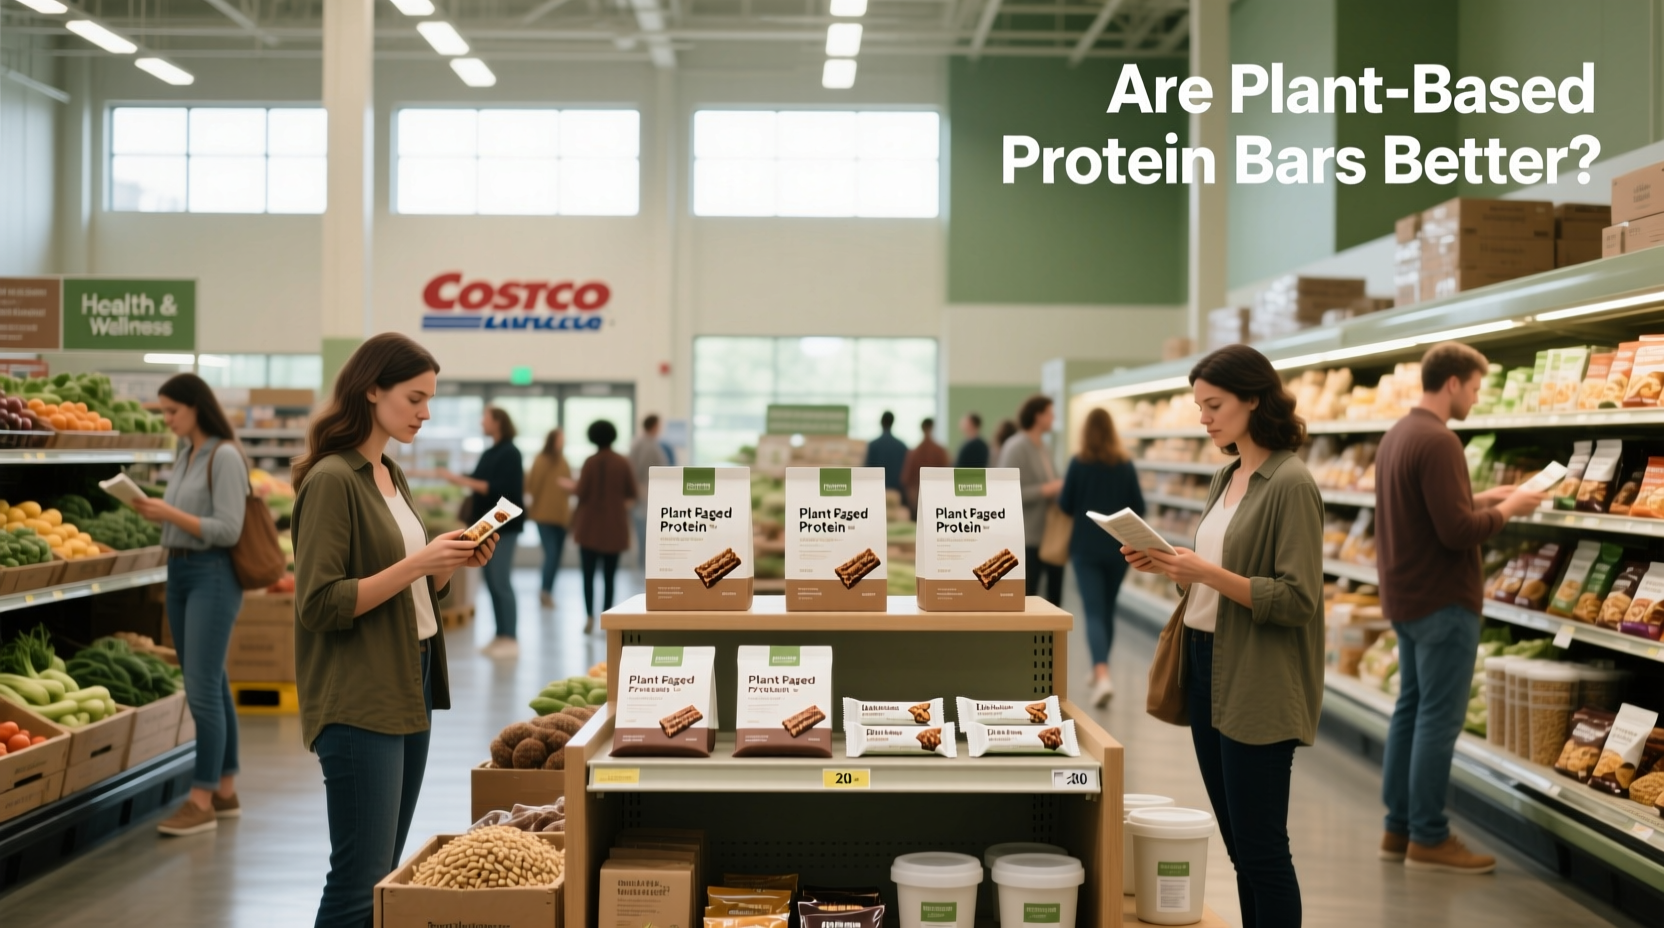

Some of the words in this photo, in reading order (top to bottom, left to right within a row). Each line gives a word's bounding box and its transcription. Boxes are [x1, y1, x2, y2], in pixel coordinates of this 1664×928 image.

[81, 293, 155, 317] Health
[160, 293, 178, 316] &
[90, 316, 173, 337] Wellness
[660, 506, 692, 519] Plant
[799, 506, 832, 520] Plant
[935, 506, 968, 520] Plant
[660, 520, 707, 533] Protein
[799, 520, 846, 533] Protein
[936, 520, 982, 534] Protein
[629, 675, 659, 685] Plant
[748, 674, 780, 685] Plant
[835, 772, 852, 785] 20
